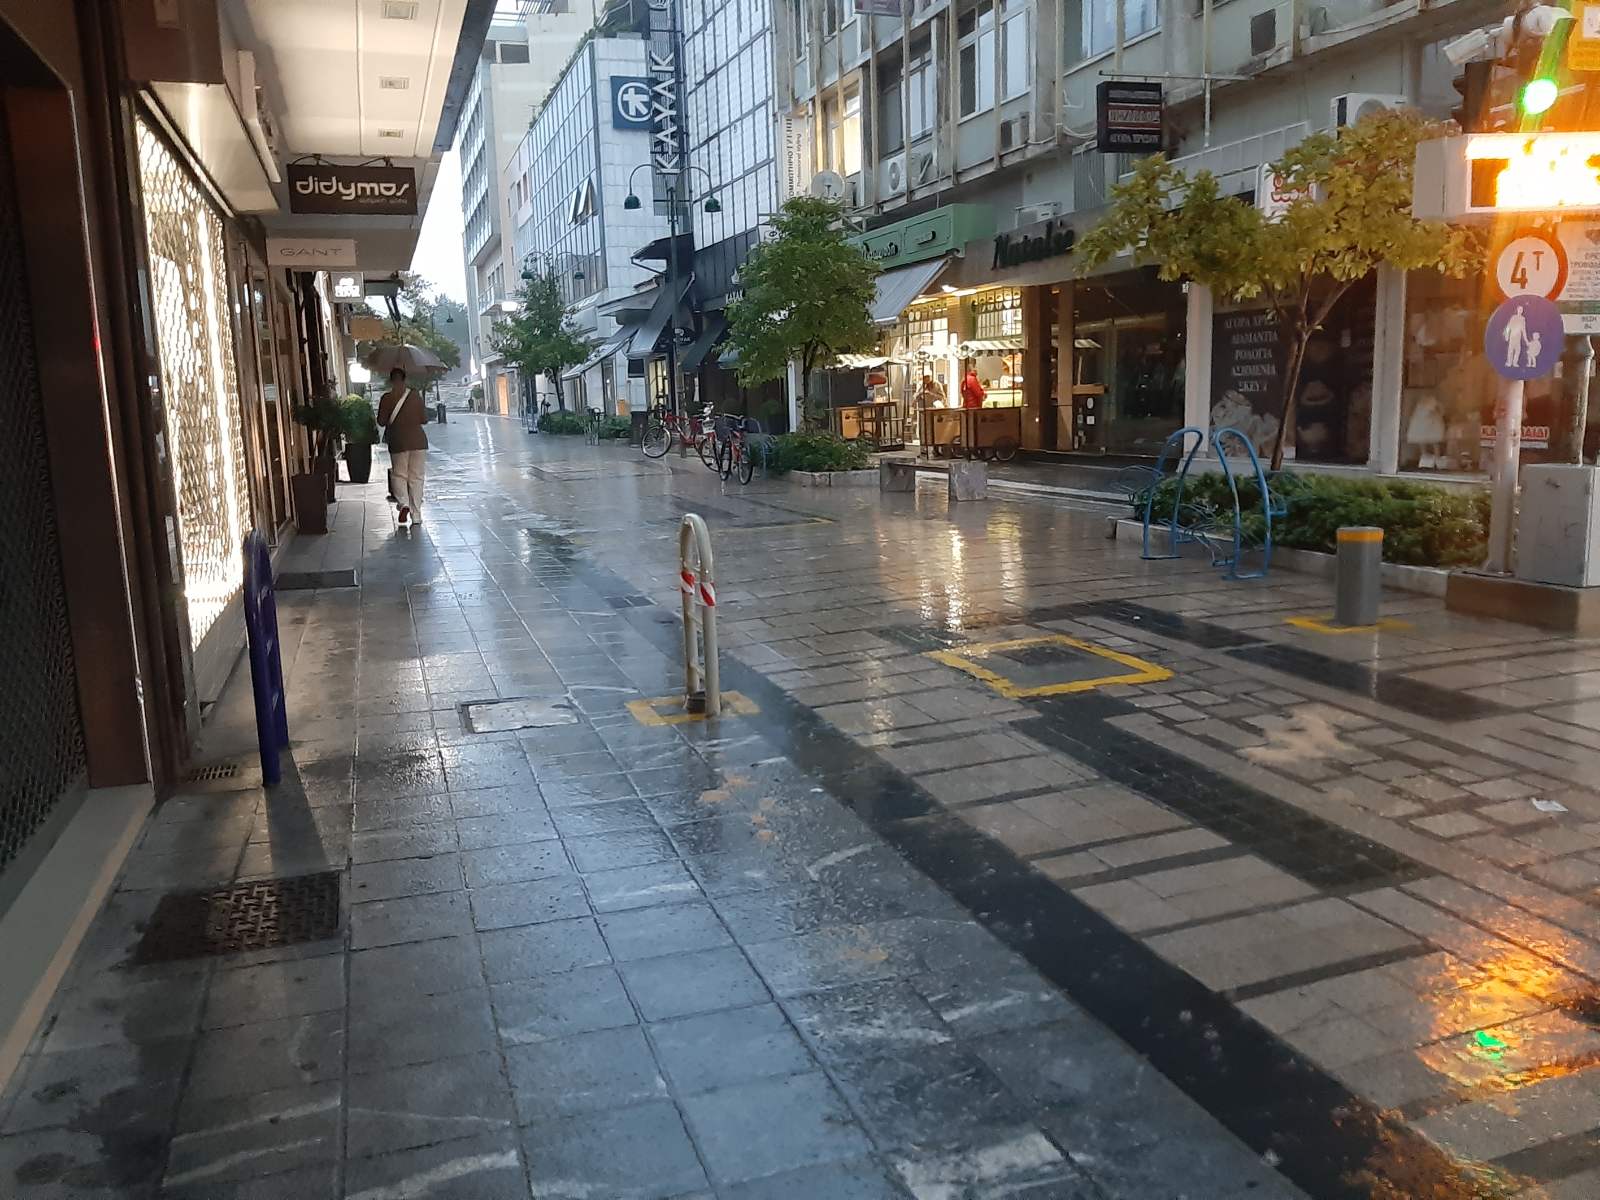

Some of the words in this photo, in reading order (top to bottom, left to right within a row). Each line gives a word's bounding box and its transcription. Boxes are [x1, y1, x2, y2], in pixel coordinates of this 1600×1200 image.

[651, 51, 682, 175] KAYAK
[296, 175, 410, 201] didymos
[787, 150, 795, 197] ΟΜΜΩΤΗΡΙΟ
[280, 247, 342, 257] GANT
